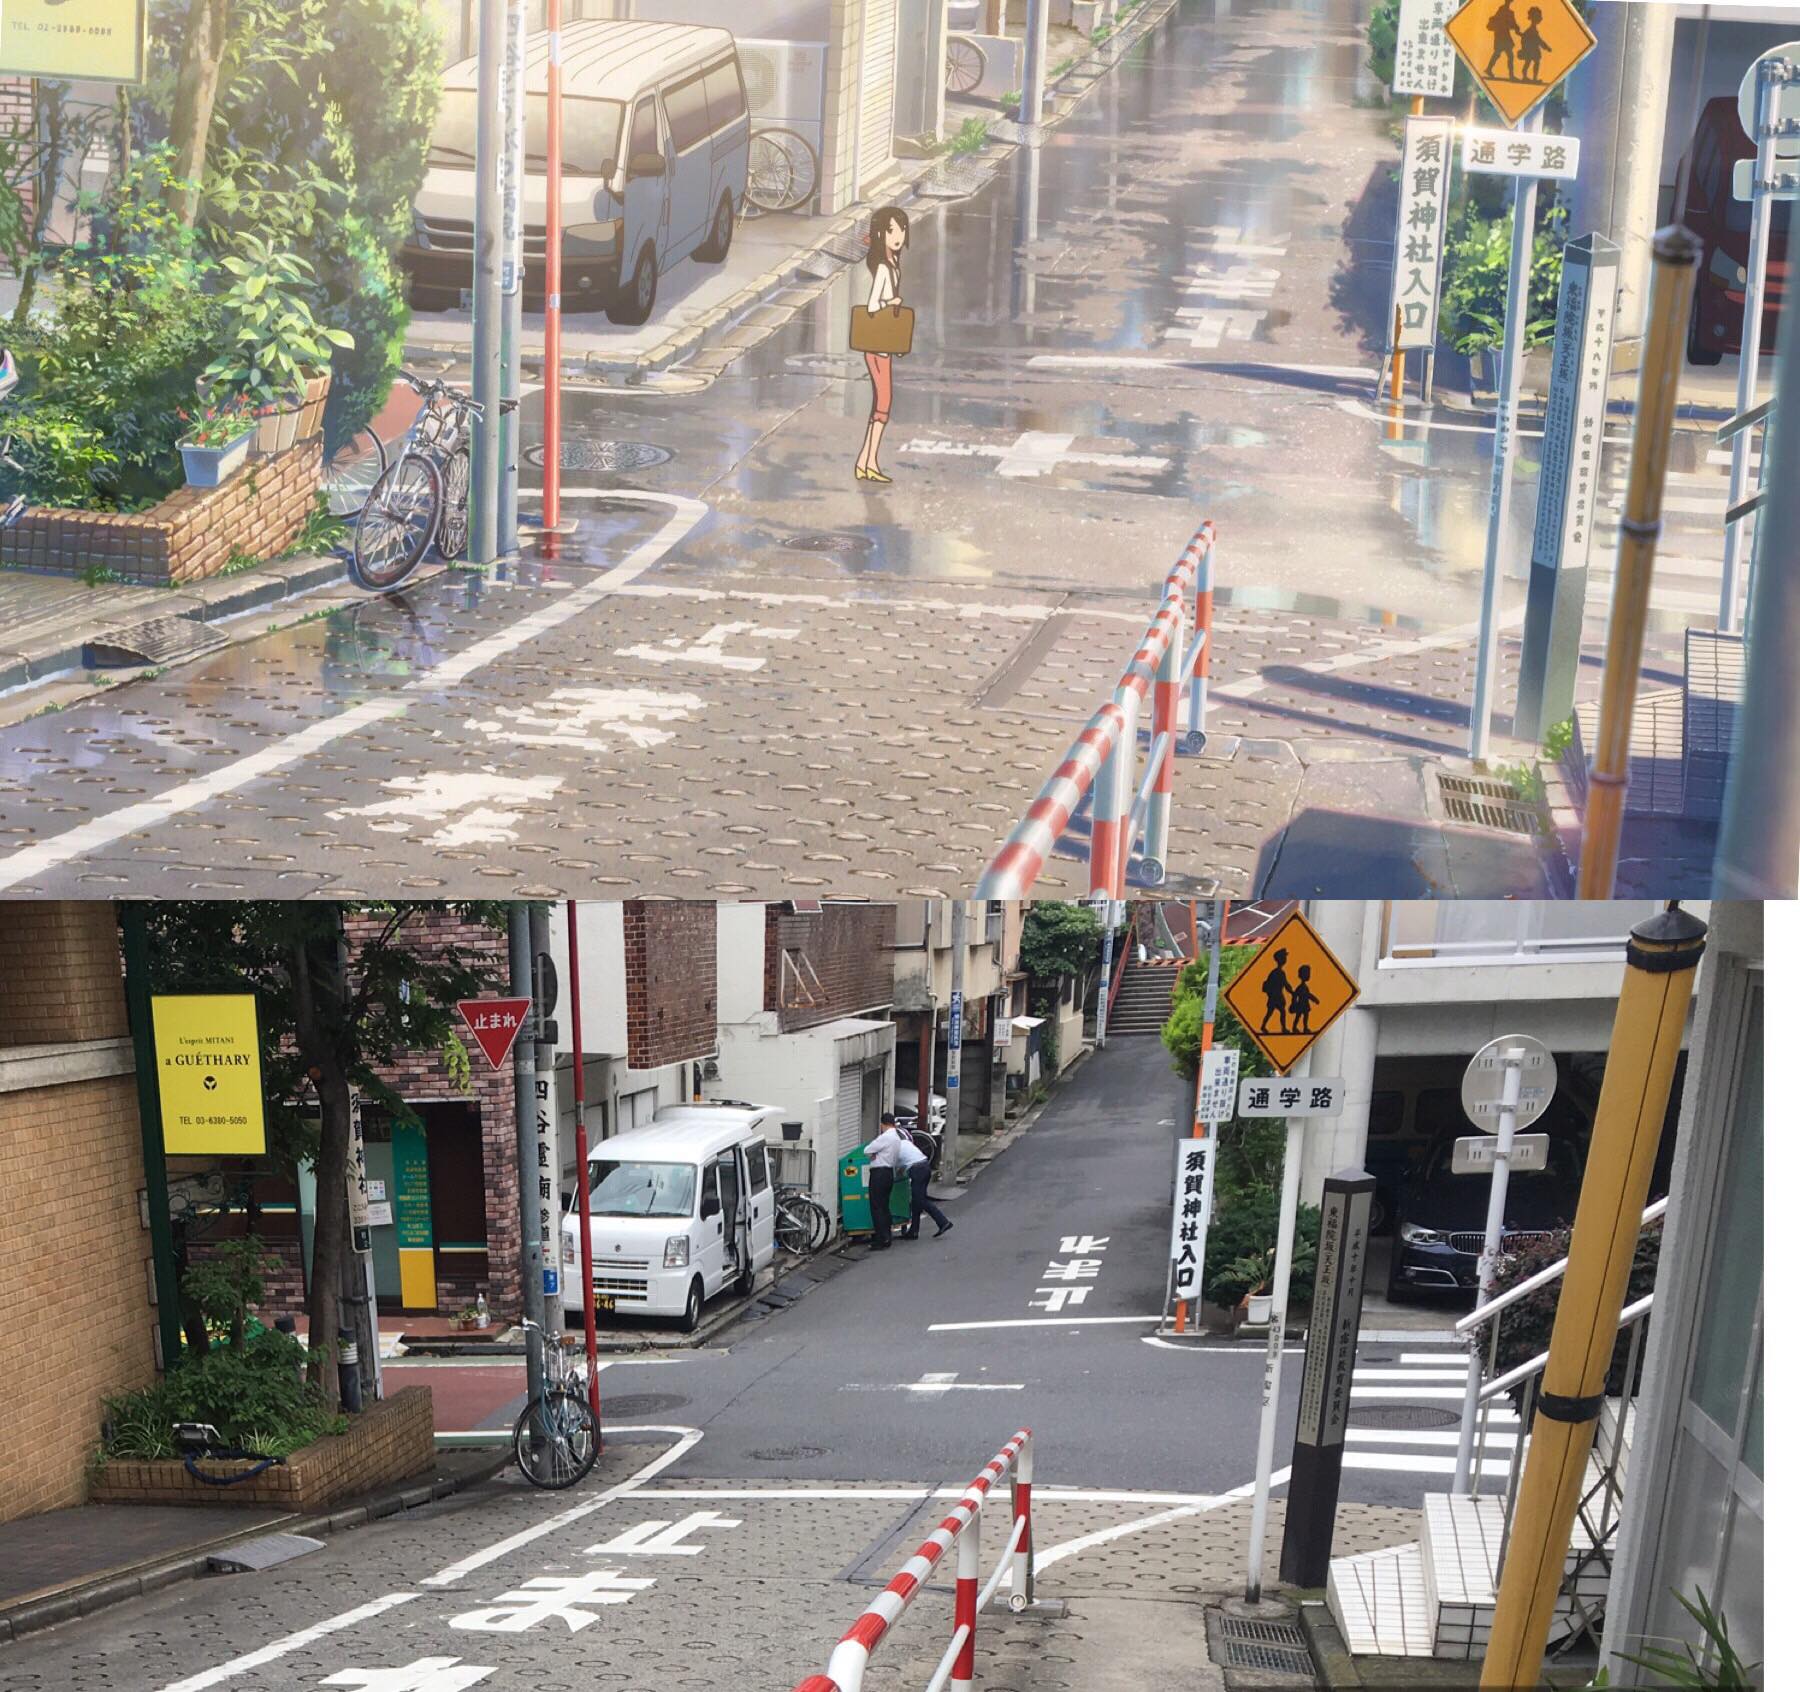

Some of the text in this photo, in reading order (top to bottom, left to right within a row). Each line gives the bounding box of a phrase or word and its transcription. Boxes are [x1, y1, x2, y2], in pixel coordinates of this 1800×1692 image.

[1470, 138, 1567, 170] 通学路
[1401, 132, 1443, 330] 須賀神社入口
[473, 1012, 518, 1029] 止まれ
[205, 1036, 235, 1044] MITANI
[165, 1051, 251, 1066] a GUÉTHARY
[1247, 1086, 1334, 1110] 通学路
[179, 1116, 192, 1125] TEL
[1177, 1150, 1206, 1288] 須賀神社入口
